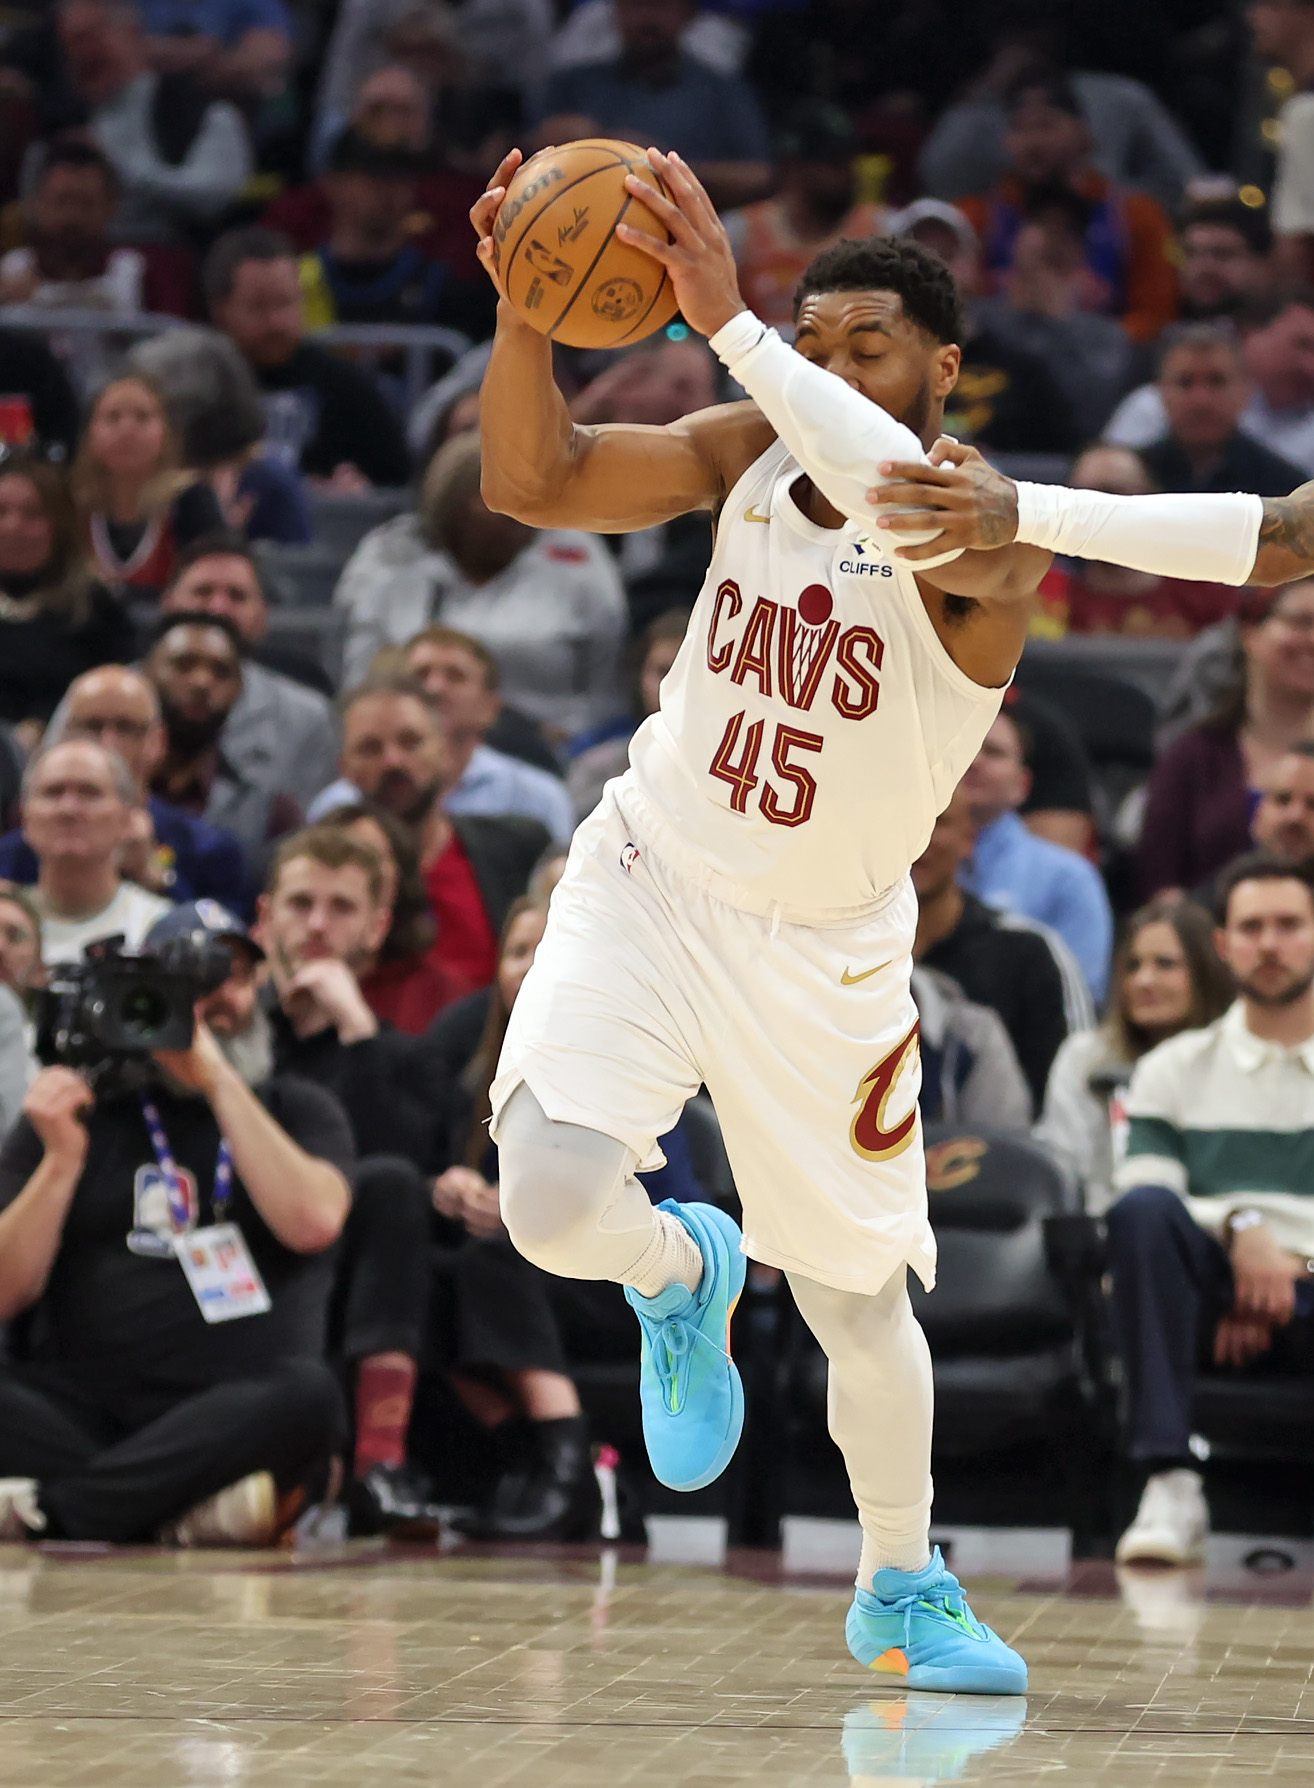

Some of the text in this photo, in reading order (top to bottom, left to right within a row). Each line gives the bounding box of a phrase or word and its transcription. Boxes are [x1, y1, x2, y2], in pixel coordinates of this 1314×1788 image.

[839, 560, 893, 578] CLIFFS
[707, 578, 885, 721] CAVS
[709, 710, 824, 828] 45
